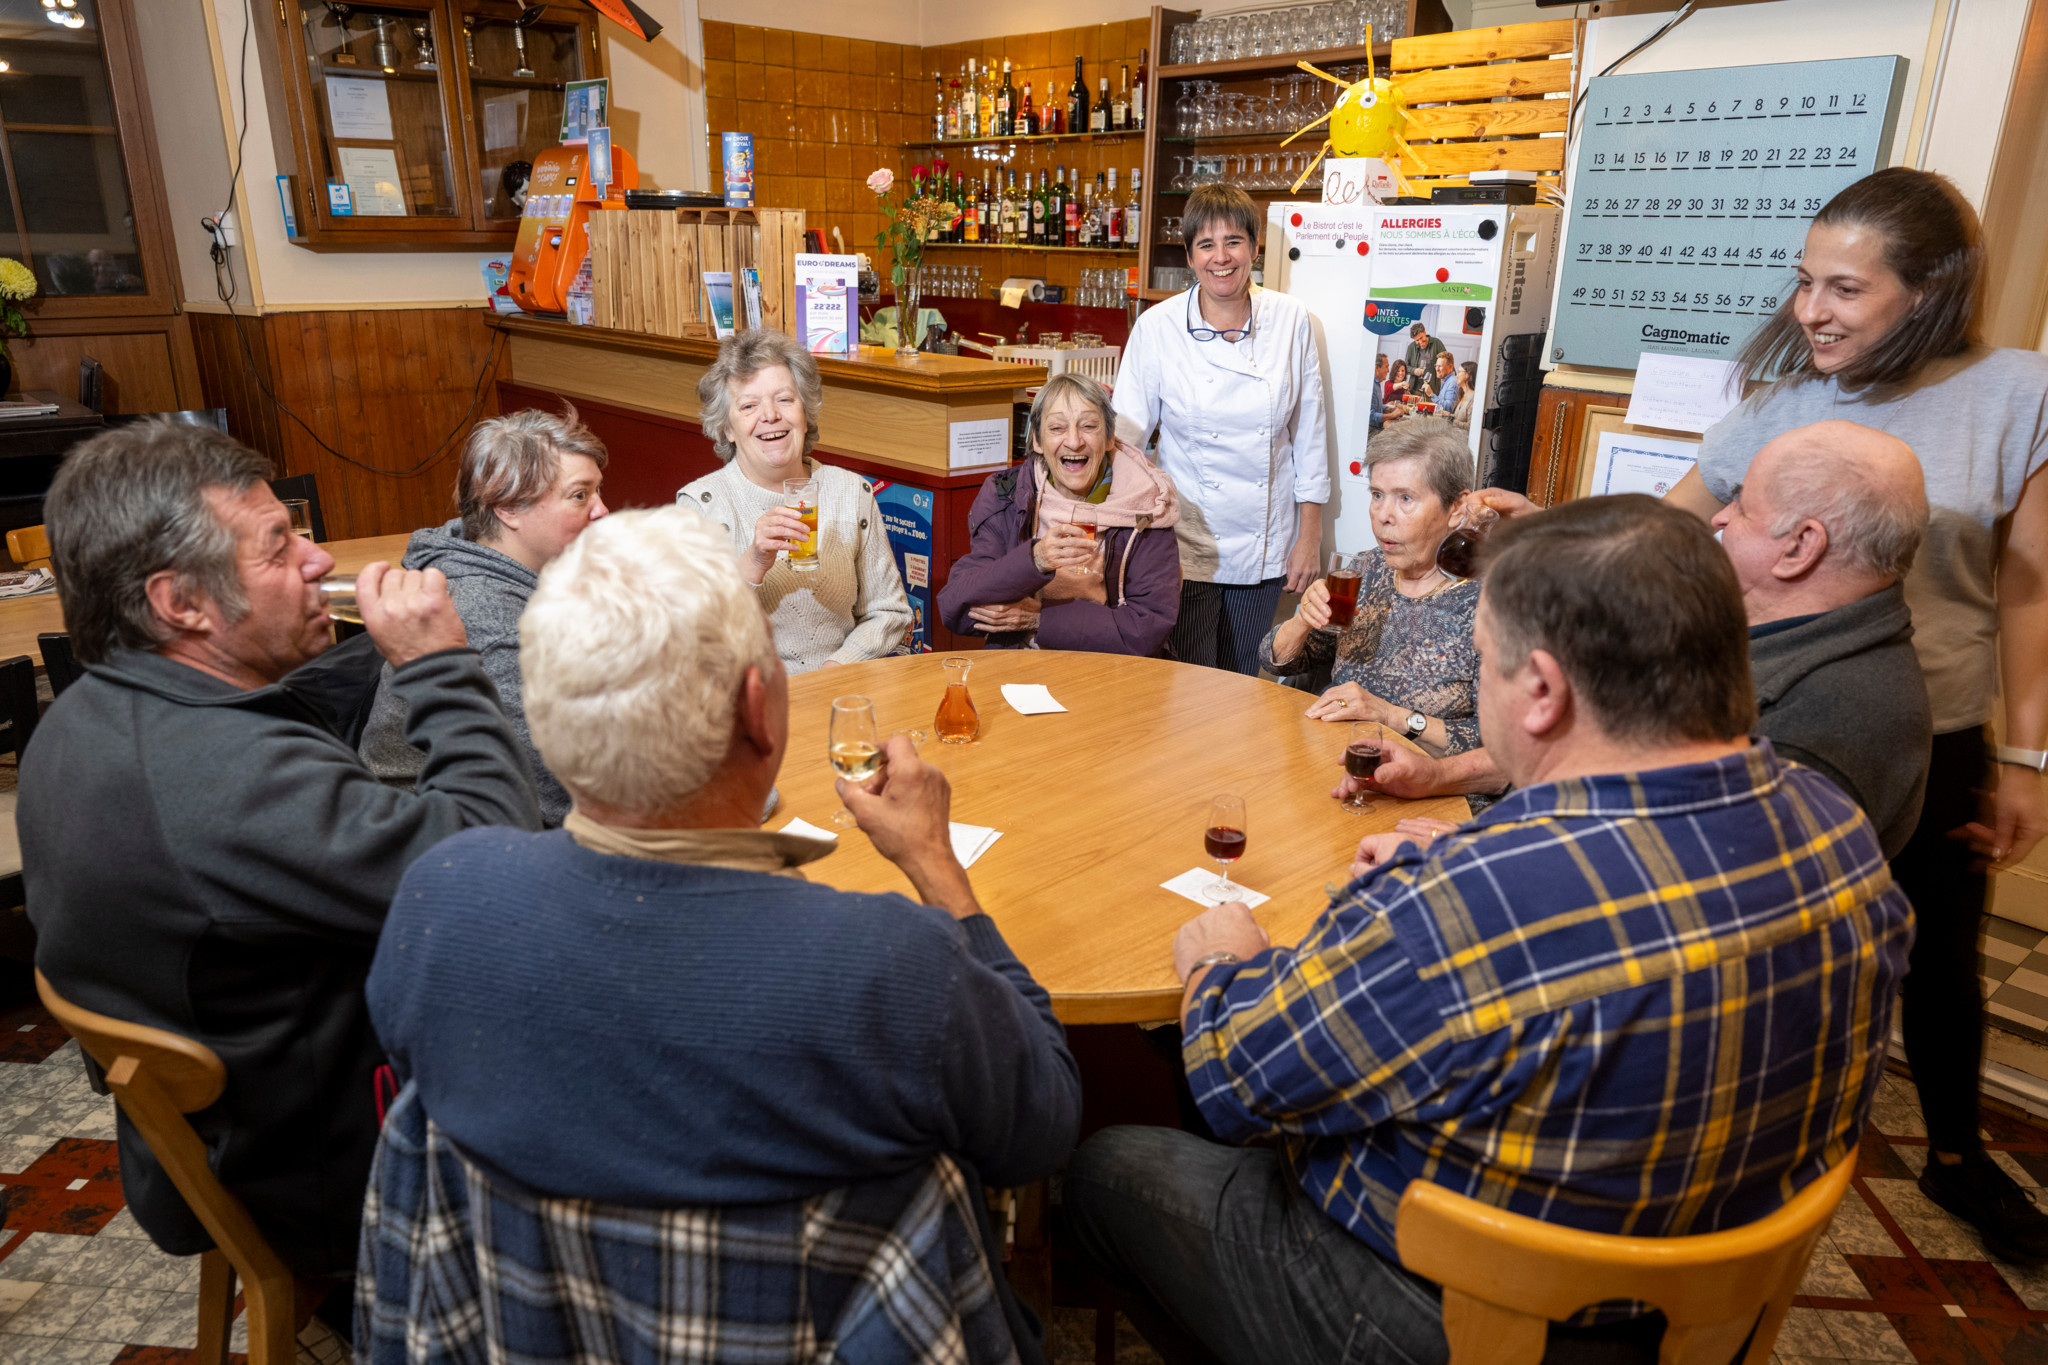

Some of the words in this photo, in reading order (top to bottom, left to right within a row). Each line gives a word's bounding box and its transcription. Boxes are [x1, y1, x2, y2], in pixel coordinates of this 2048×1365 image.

[1622, 105, 1631, 118] 2
[1643, 104, 1652, 117] 3
[1663, 103, 1672, 116] 4
[1686, 102, 1696, 115] 5
[1707, 100, 1717, 114] 6
[1731, 99, 1743, 113] 7
[1754, 98, 1764, 112] 8
[1779, 96, 1789, 110] 9
[1801, 95, 1816, 110] 10
[1828, 94, 1839, 108] 11
[1852, 93, 1867, 107] 12
[1593, 153, 1606, 165] 13
[1613, 152, 1625, 165] 14
[1634, 151, 1646, 164] 15
[1654, 151, 1667, 164] 16
[1676, 150, 1690, 164] 17
[1698, 149, 1711, 163] 18
[1720, 149, 1734, 162] 19
[1740, 148, 1759, 162] 20
[1765, 148, 1781, 161] 21
[1787, 147, 1807, 161] 22
[1813, 146, 1832, 161] 23
[1837, 146, 1857, 160] 24
[1584, 198, 1600, 210] 25
[1604, 198, 1620, 210] 26
[1623, 198, 1641, 210] 27
[1644, 198, 1661, 211] 28
[1665, 198, 1682, 211] 29
[1687, 198, 1704, 211] 30
[1710, 198, 1725, 211] 31
[1732, 197, 1750, 211] 32
[1755, 197, 1772, 211] 33
[1778, 197, 1796, 211] 34
[1803, 198, 1821, 211] 35
[1303, 221, 1311, 230] Le
[1313, 221, 1336, 230] Bistrot
[1337, 221, 1354, 230] c'est
[1355, 221, 1363, 230] le
[1380, 218, 1442, 229] ALLERGIES
[1295, 231, 1330, 240] Parlement
[1332, 232, 1342, 240] du
[1343, 232, 1369, 242] Peuple
[1380, 230, 1403, 239] NOUS
[1405, 230, 1442, 239] SOMMES
[1443, 229, 1450, 239] À
[1578, 243, 1594, 255] 37
[1597, 243, 1613, 256] 38
[1617, 243, 1633, 256] 39
[1637, 244, 1654, 257] 40
[1659, 245, 1673, 257] 41
[1679, 245, 1695, 258] 42
[1700, 246, 1718, 259] 43
[1722, 246, 1740, 259] 44
[1745, 247, 1763, 260] 45
[1769, 247, 1787, 261] 46
[1793, 249, 1804, 260] 4
[797, 259, 818, 267] EURO
[824, 260, 857, 268] DREAMS
[1510, 258, 1526, 315] ntan
[1572, 287, 1587, 298] 49
[1590, 287, 1606, 300] 50
[1611, 288, 1625, 301] 51
[1630, 289, 1646, 302] 52
[1650, 290, 1666, 303] 53
[1671, 291, 1687, 304] 54
[1692, 292, 1710, 305] 55
[1714, 293, 1732, 306] 56
[1736, 295, 1756, 308] 57
[1760, 296, 1778, 309] 58
[1376, 308, 1399, 317] INTES
[1641, 324, 1730, 346] Cagnomatic
